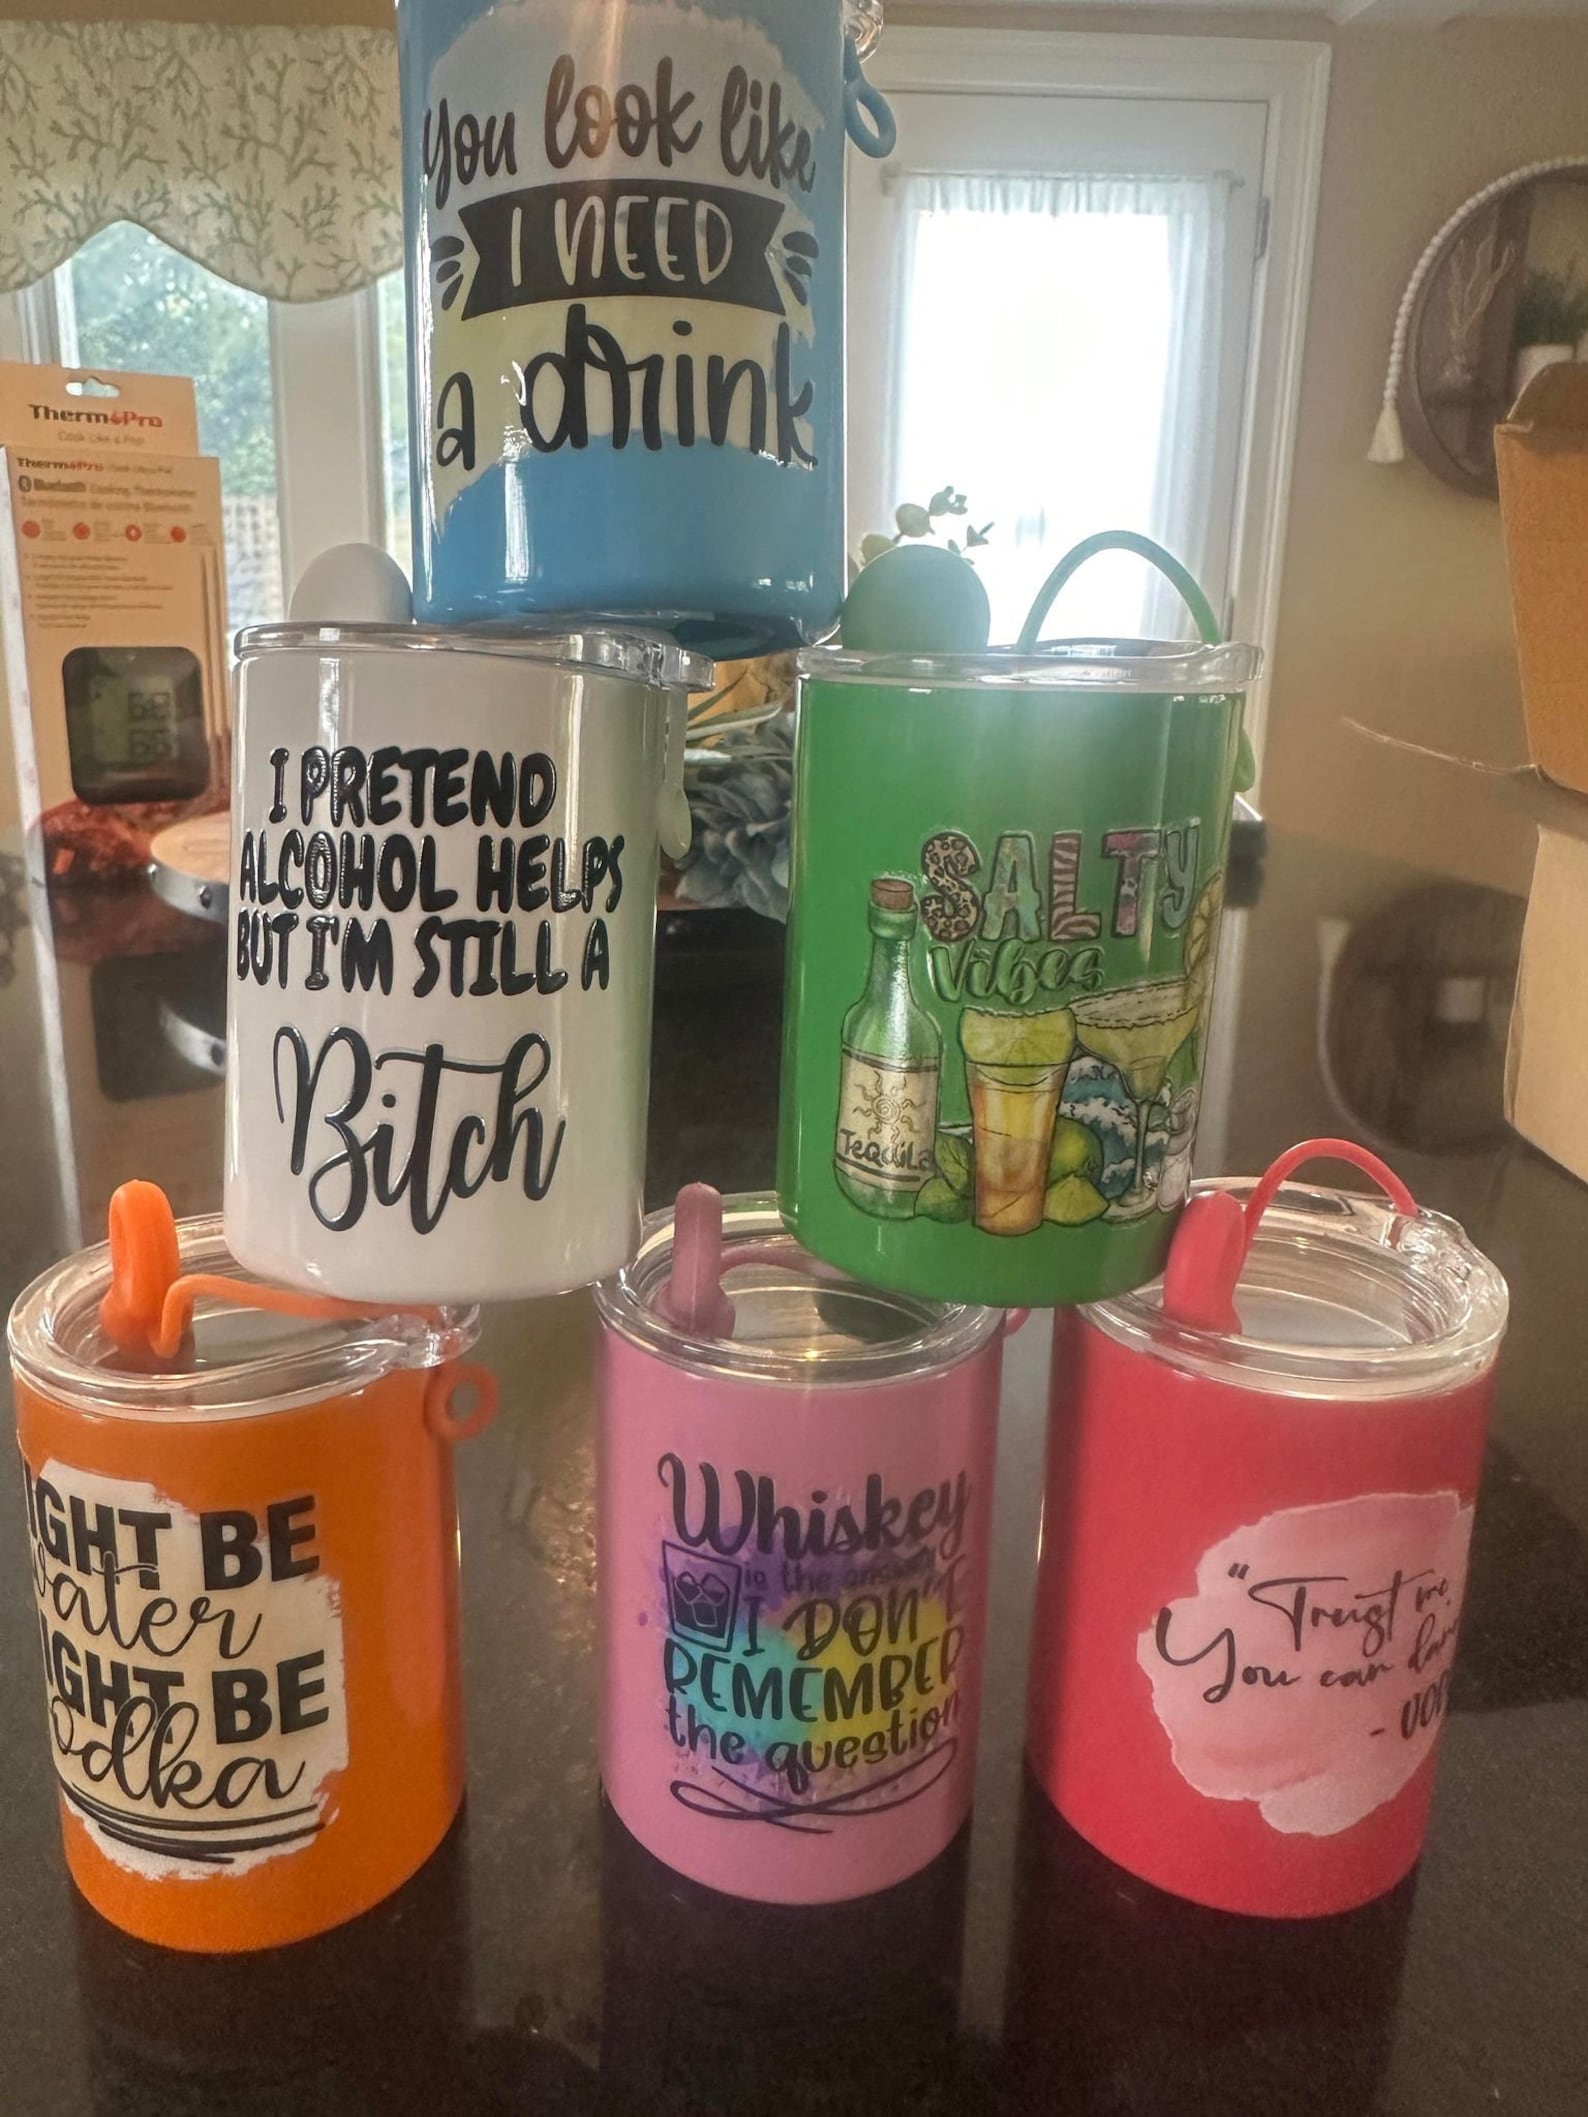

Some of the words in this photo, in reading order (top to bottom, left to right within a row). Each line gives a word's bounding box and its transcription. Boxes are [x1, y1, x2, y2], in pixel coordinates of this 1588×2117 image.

[423, 98, 517, 209] you
[544, 54, 703, 168] look
[720, 65, 816, 192] like
[510, 206, 523, 288] I
[554, 194, 733, 287] NEED
[436, 371, 476, 471] a
[520, 303, 818, 468] drink
[268, 747, 290, 824] I
[300, 745, 556, 828] PRETEND
[239, 828, 458, 911] ALCOHOL
[476, 834, 625, 914] HELPS
[920, 817, 1199, 943] SALTY
[236, 907, 299, 989] BUT
[304, 915, 394, 996] I'M
[413, 915, 568, 998] STILL
[580, 918, 610, 991] A
[928, 936, 1105, 1005] Vibes
[272, 1026, 567, 1235] Bitch
[24, 1461, 172, 1590] IGHT
[200, 1495, 320, 1592] BE
[658, 1452, 970, 1561] Whiskey
[742, 1595, 766, 1657] I
[782, 1554, 966, 1661] DON'T
[1155, 1606, 1301, 1704] You
[1320, 1661, 1395, 1688] can
[40, 1609, 185, 1744] IGHT
[211, 1650, 330, 1745] BE
[663, 1625, 964, 1723] REMEMBER
[52, 1696, 305, 1810] odka
[665, 1692, 746, 1765] the
[765, 1692, 960, 1795] question
